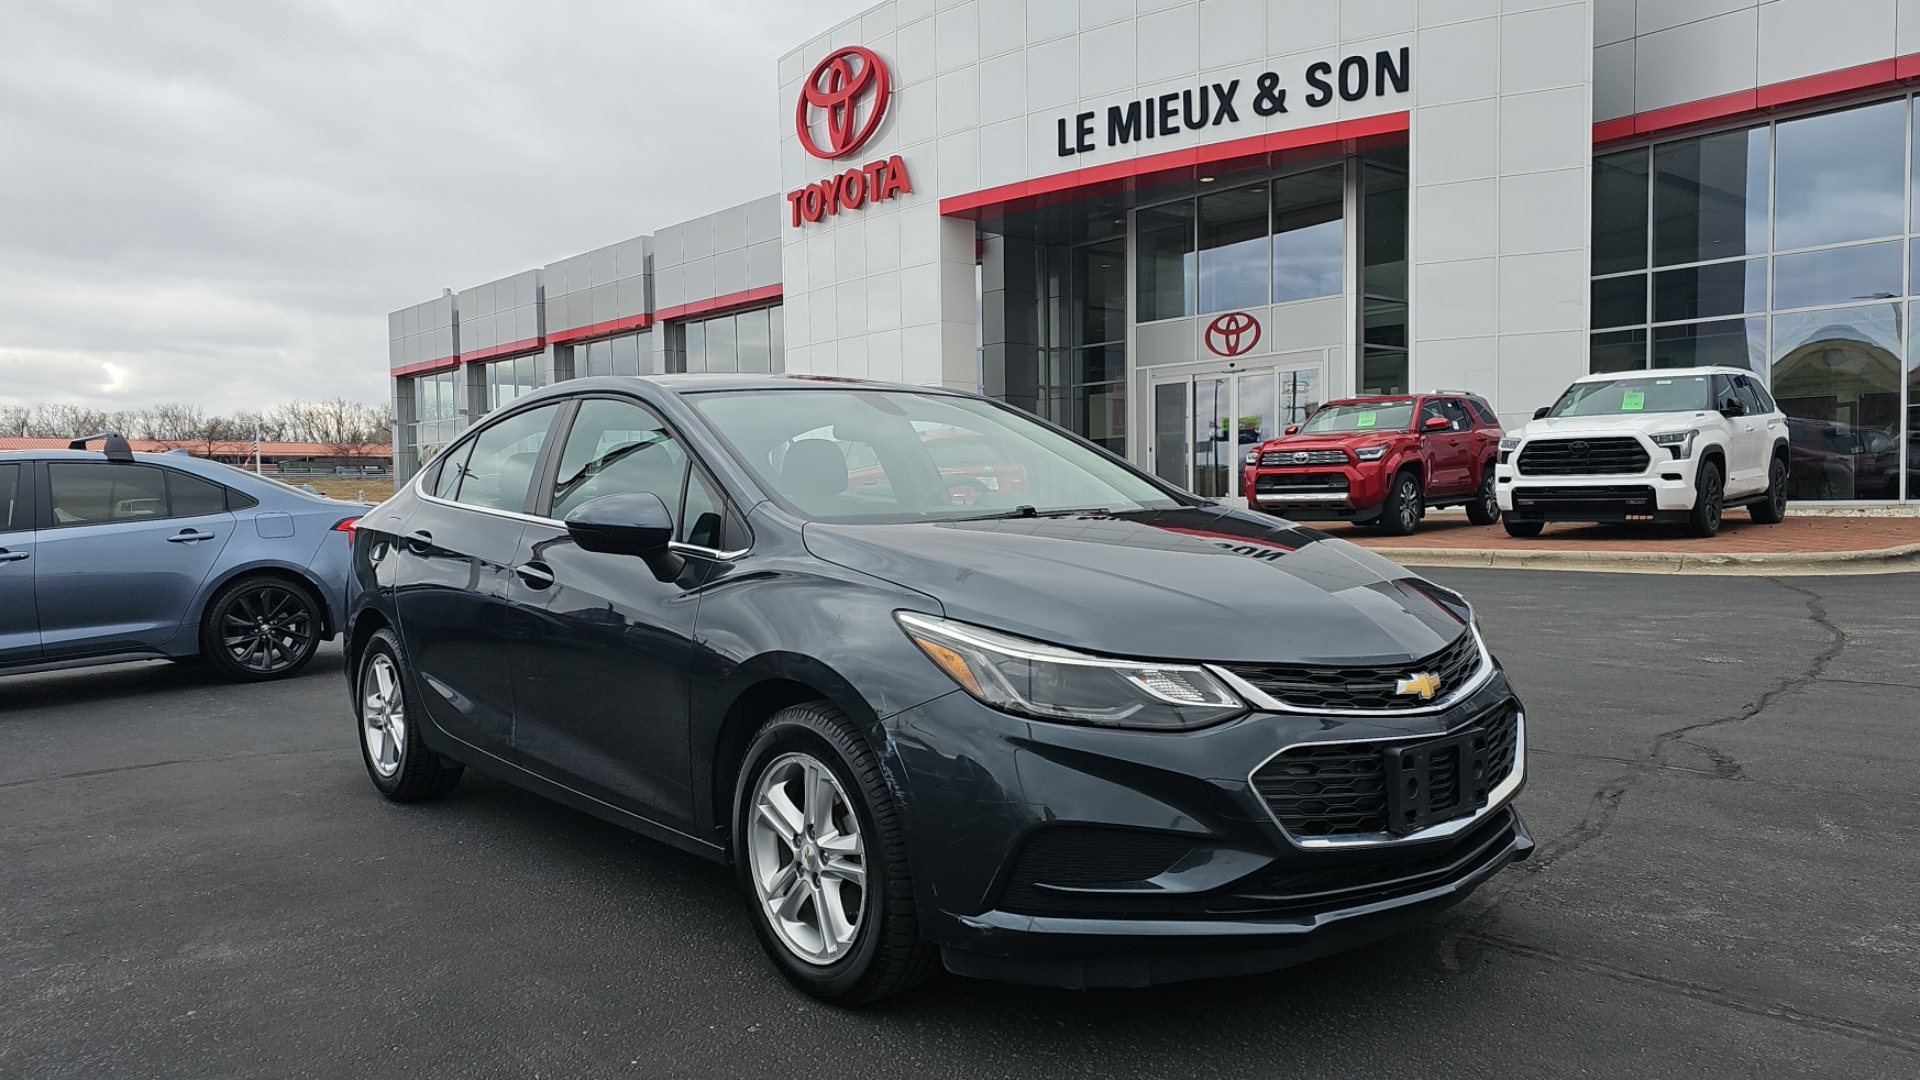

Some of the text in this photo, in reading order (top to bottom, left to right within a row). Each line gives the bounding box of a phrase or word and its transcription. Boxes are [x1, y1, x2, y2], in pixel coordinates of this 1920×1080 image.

[1057, 46, 1410, 157] LE MIEUX & SON
[787, 155, 912, 228] TOYOTA
